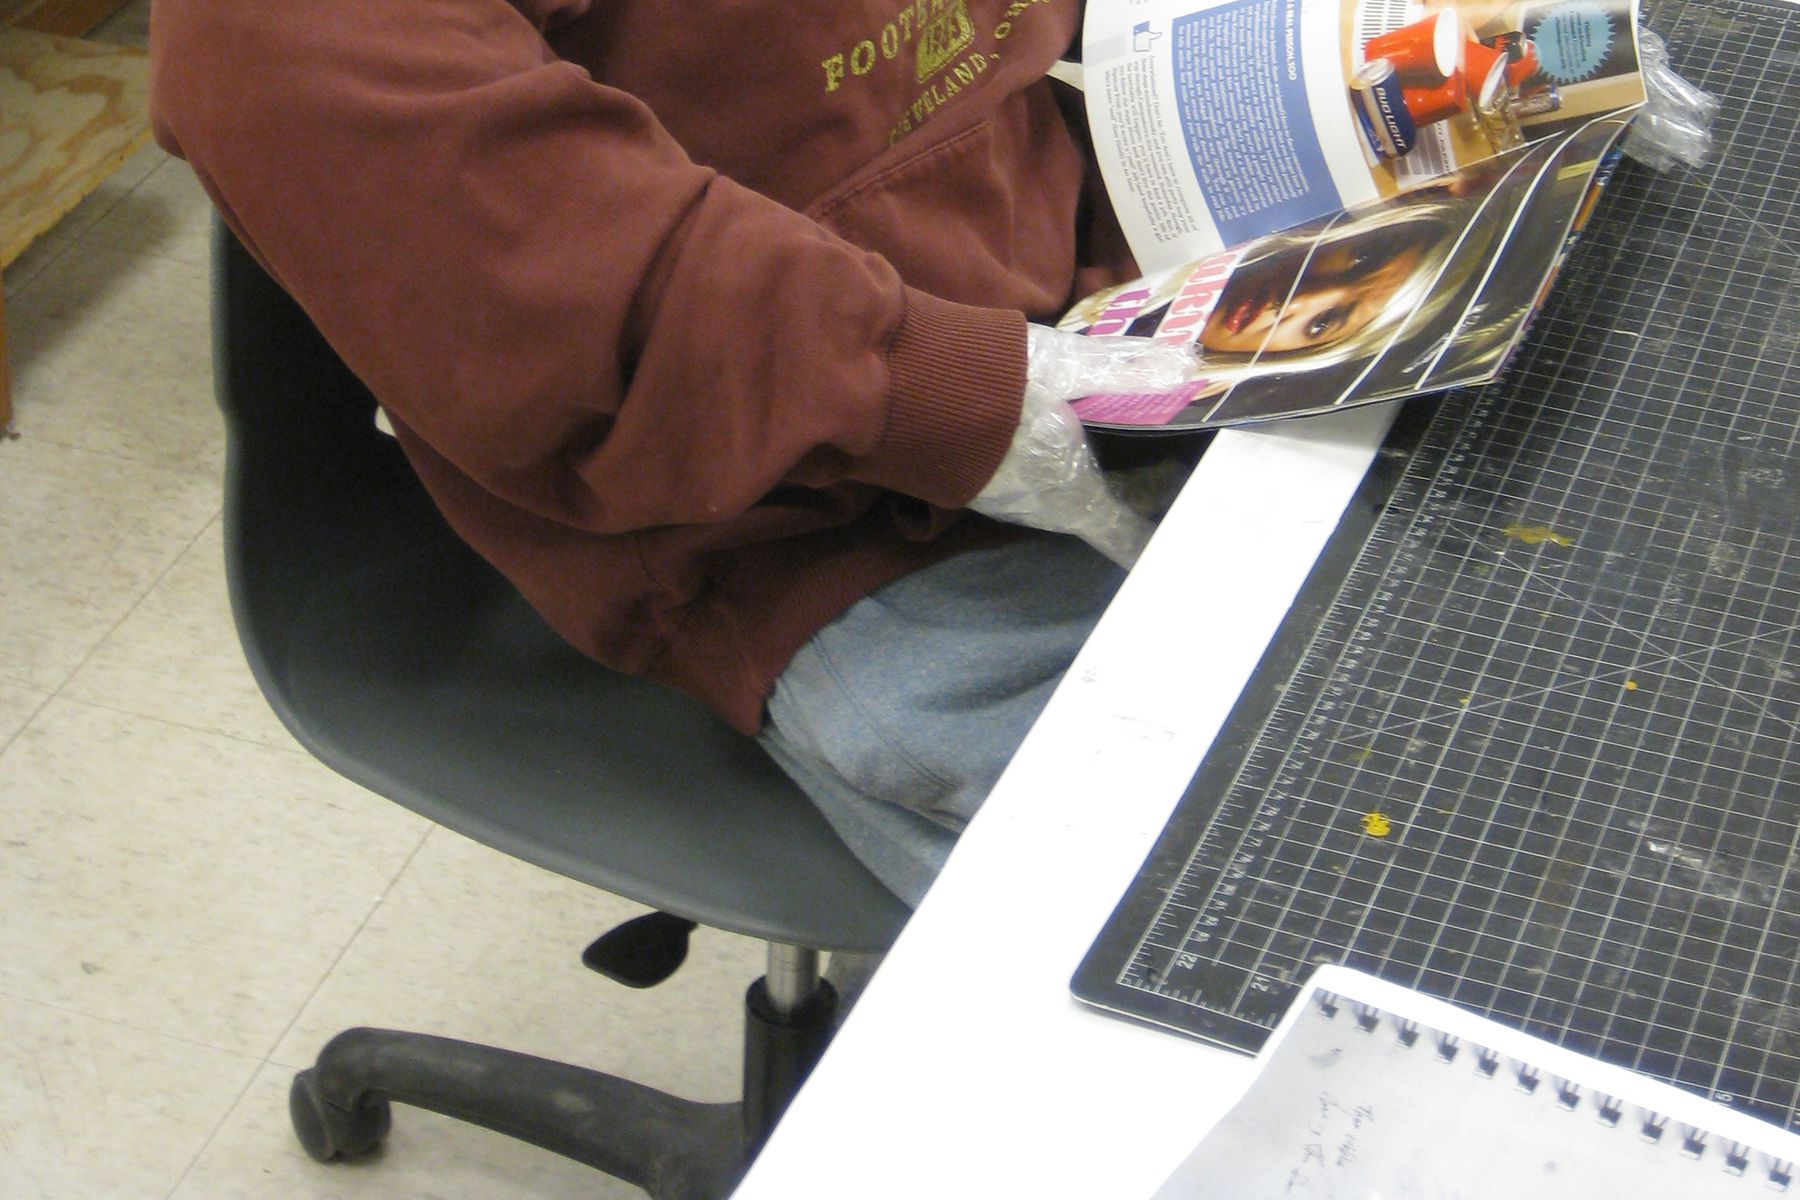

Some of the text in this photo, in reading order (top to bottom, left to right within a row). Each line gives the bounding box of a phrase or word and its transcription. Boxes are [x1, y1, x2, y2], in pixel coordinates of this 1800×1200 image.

[1376, 87, 1406, 148] BUD LIGHT
[1175, 953, 1198, 970] 22
[1251, 975, 1270, 992] 21
